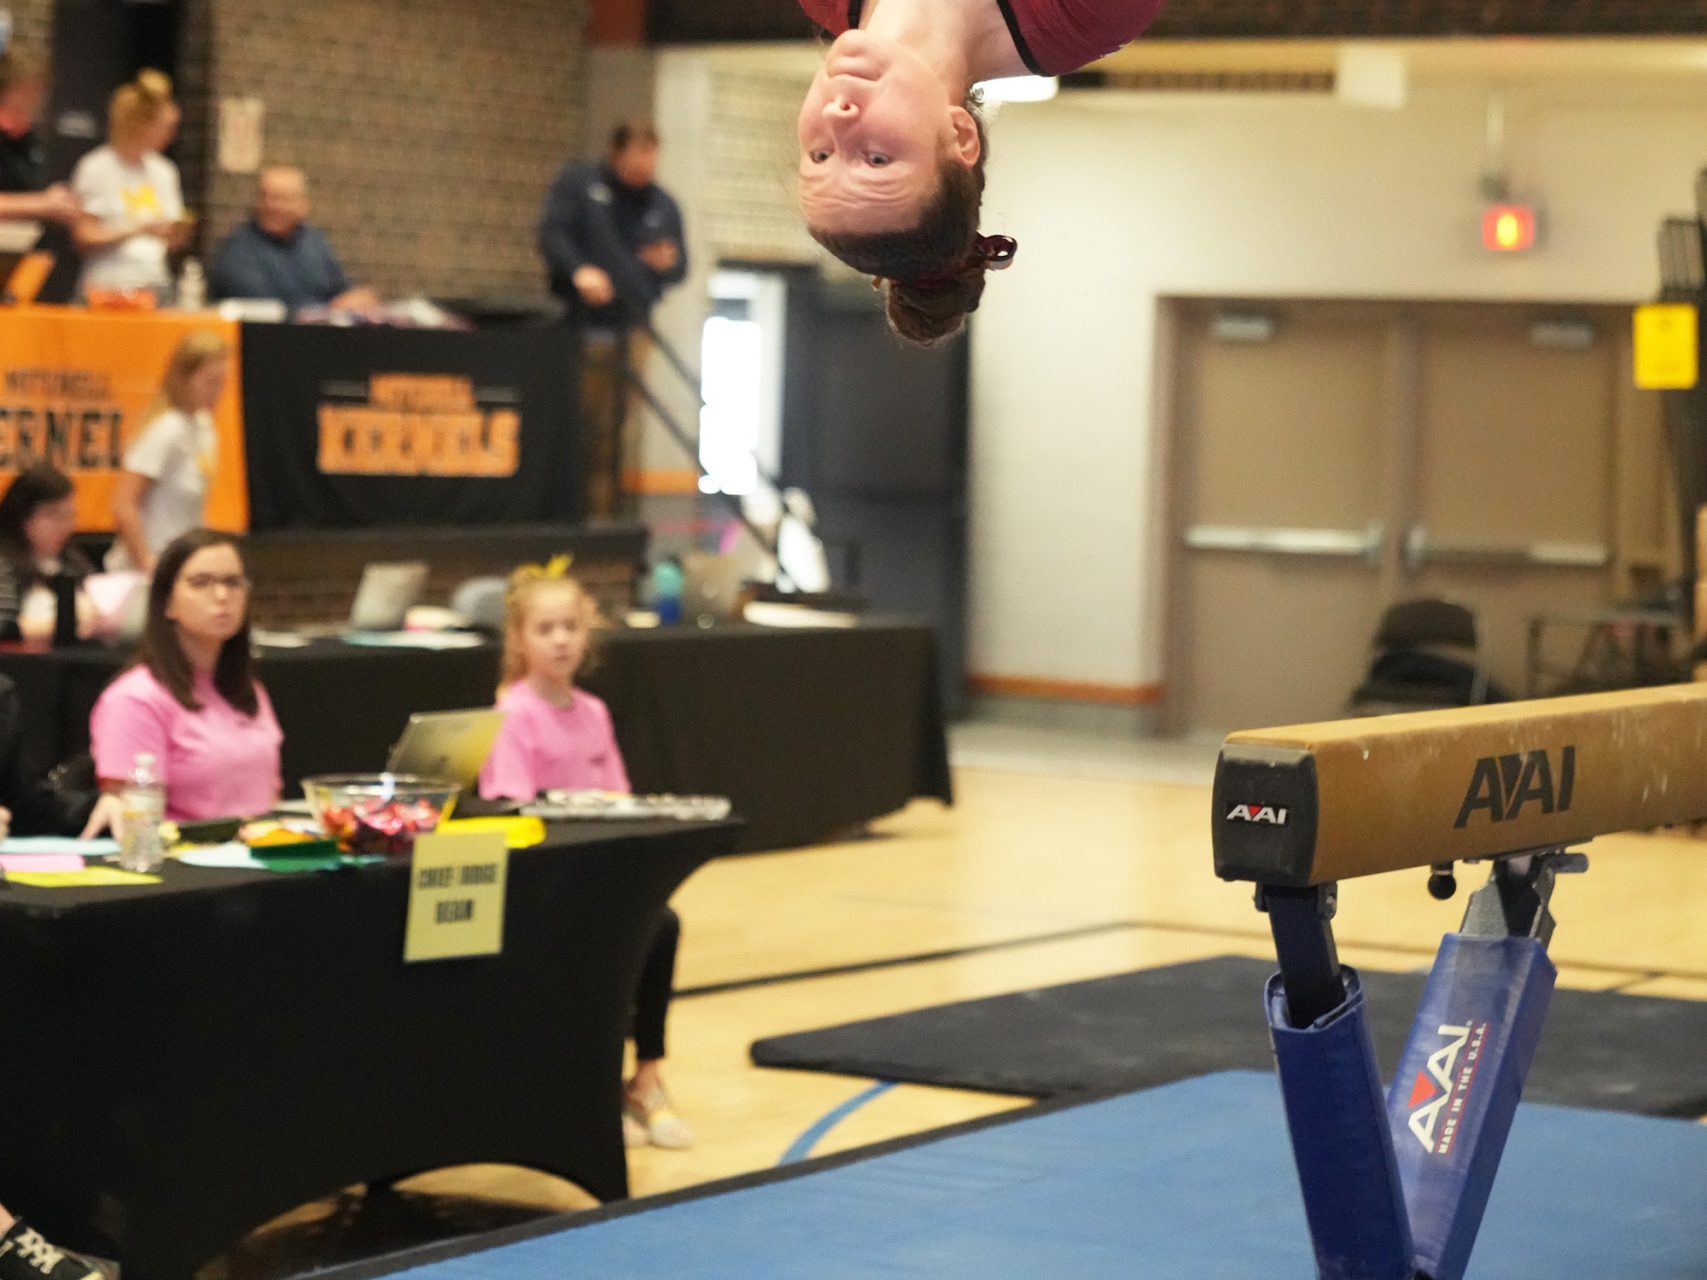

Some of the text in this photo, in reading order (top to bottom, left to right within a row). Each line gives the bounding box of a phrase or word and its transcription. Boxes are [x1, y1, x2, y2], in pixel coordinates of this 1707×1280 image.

[1438, 1118, 1458, 1154] MADE
[1451, 1098, 1463, 1112] IN
[1458, 1067, 1474, 1091] THE
